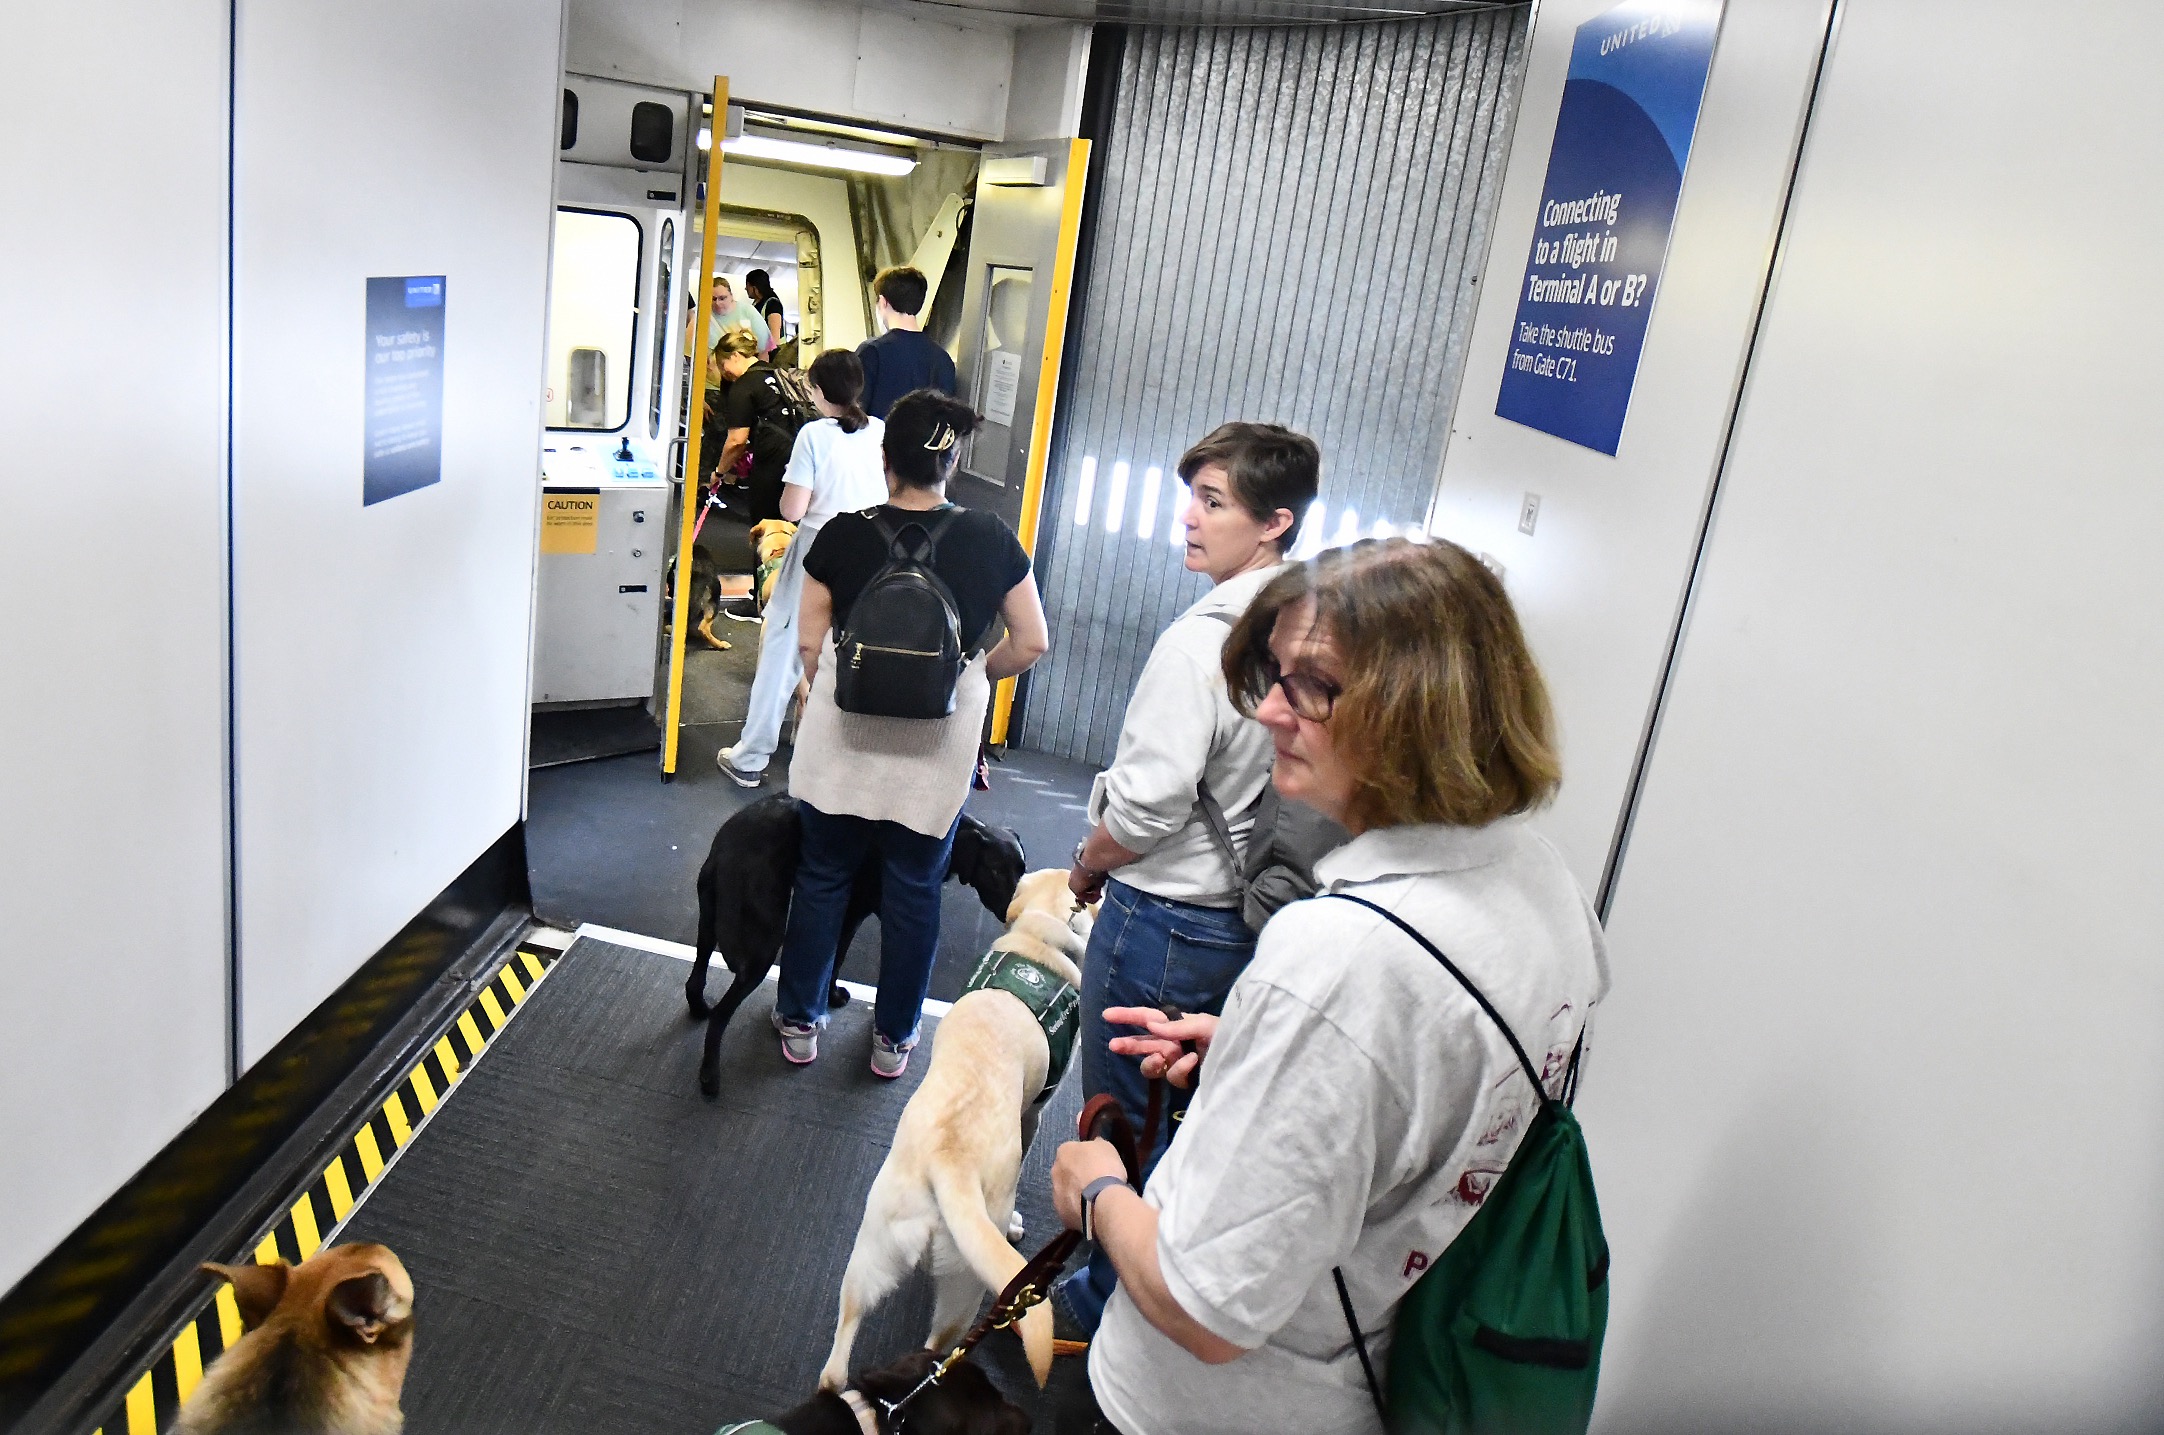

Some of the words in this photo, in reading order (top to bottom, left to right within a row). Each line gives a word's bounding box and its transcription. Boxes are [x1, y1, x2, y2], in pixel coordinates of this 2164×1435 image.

[1600, 14, 1661, 56] UNITED
[1543, 189, 1622, 228] Connecting
[1535, 238, 1550, 265] to
[1549, 240, 1560, 264] a
[1560, 232, 1600, 269] flight
[1600, 230, 1618, 262] in
[1528, 272, 1587, 304] Terminal
[1584, 274, 1598, 305] A
[1600, 279, 1622, 306] or
[1621, 274, 1647, 307] B?
[1518, 321, 1539, 344] Take
[1539, 323, 1556, 347] the
[1555, 325, 1592, 352] shuttle
[1592, 328, 1616, 356] bus
[1512, 348, 1534, 373] from
[1533, 352, 1556, 378] Gate
[1556, 356, 1577, 382] C71.
[547, 500, 593, 510] CAUTION
